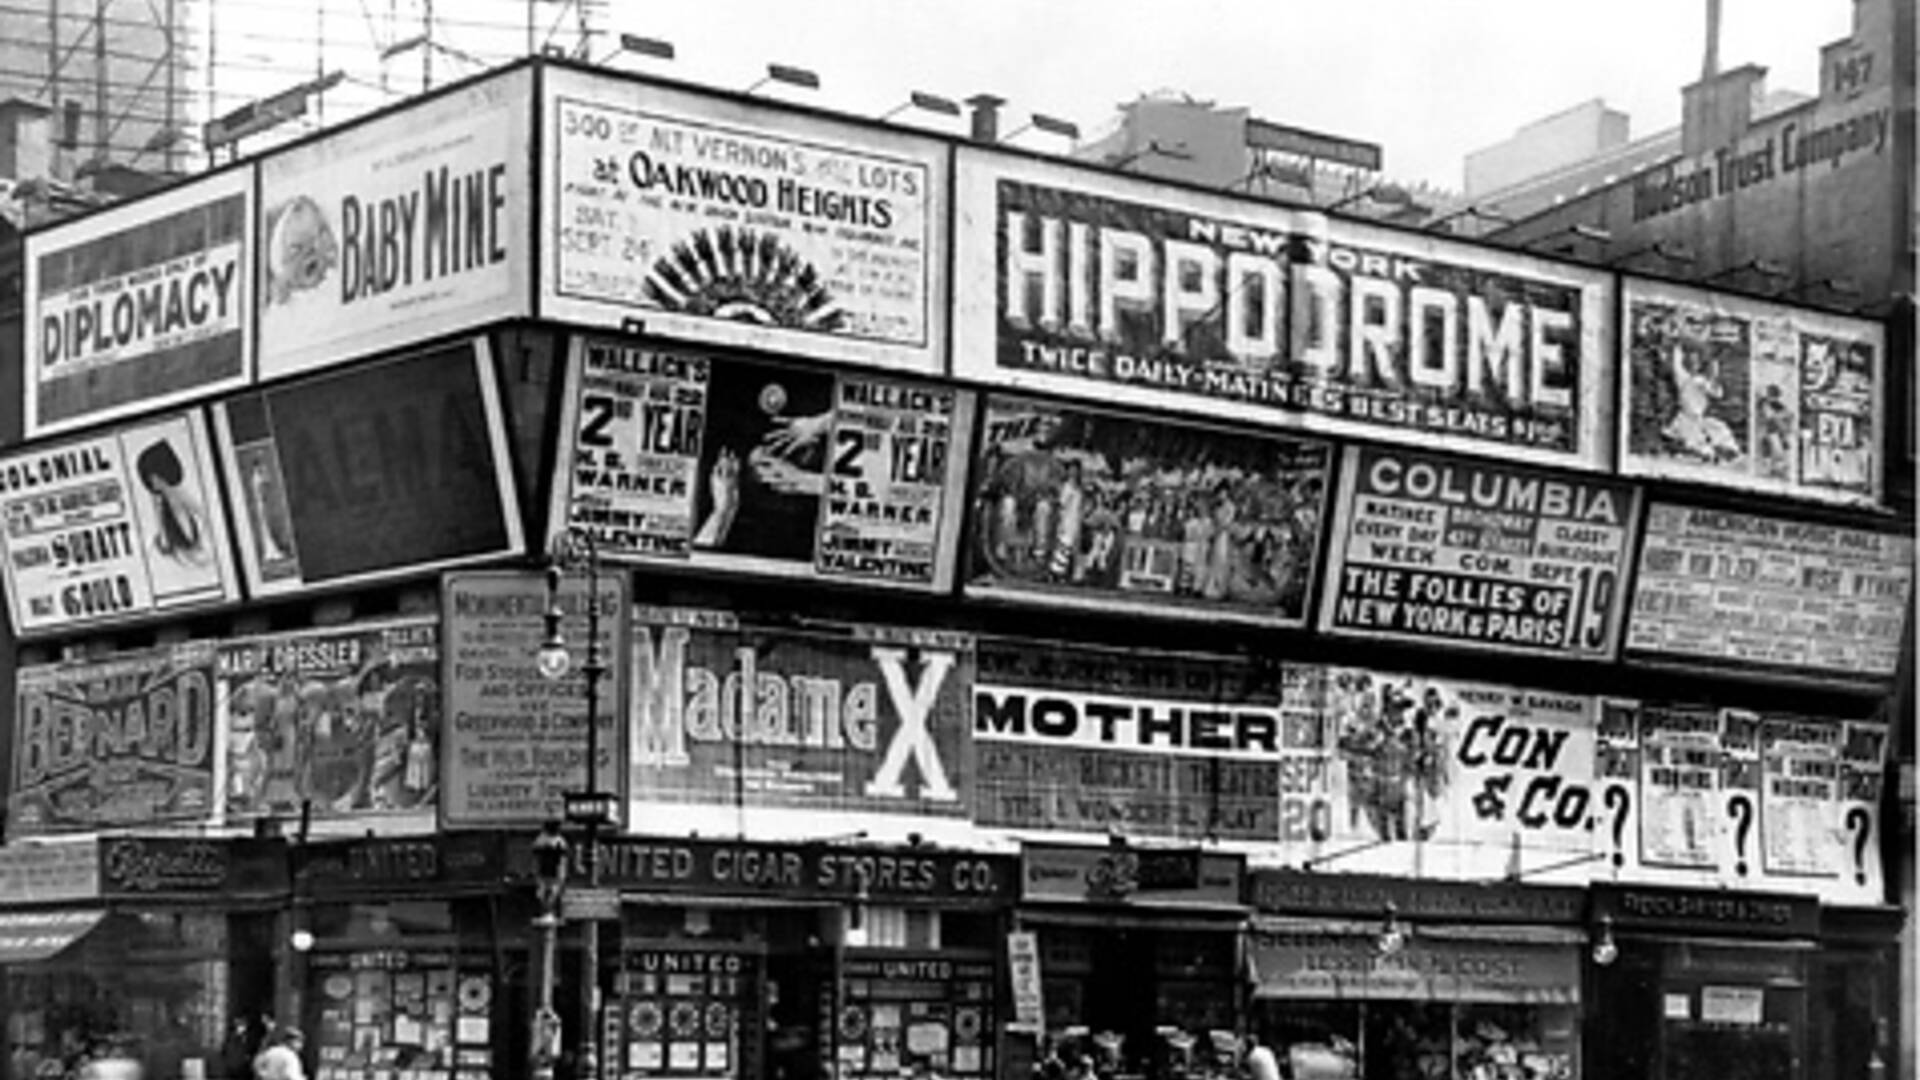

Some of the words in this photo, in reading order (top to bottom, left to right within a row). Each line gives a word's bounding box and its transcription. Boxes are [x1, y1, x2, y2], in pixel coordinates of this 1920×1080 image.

[565, 111, 610, 139] 300
[858, 164, 917, 196] LOTS
[1715, 138, 1774, 196] Trust
[1782, 107, 1889, 173] Company
[629, 151, 767, 209] OAKWOOD
[778, 178, 892, 229] HEIGHTS
[342, 191, 419, 305] BABY
[425, 164, 505, 281] MINE
[1189, 219, 1288, 259] NEW
[1307, 243, 1421, 281] YORK
[43, 261, 235, 366] DIPLOMACY
[1004, 210, 1572, 405] HIPPODROME
[1020, 341, 1103, 374] TWICE
[1351, 397, 1419, 425] BEST
[1427, 404, 1504, 434] SEATS
[641, 406, 699, 455] YEAR
[577, 470, 686, 497] WARNER
[890, 437, 945, 485] YEAR
[1370, 458, 1617, 522] COLUMBIA
[830, 502, 932, 524] WARNER
[1370, 543, 1433, 564] WEEK
[1339, 599, 1398, 624] NEW
[1348, 567, 1400, 596] THE
[1410, 574, 1525, 612] FOLLIES
[1533, 590, 1567, 616] OF
[275, 639, 360, 671] DRESSLER
[21, 670, 210, 787] BERNARD
[632, 626, 877, 769] Madame
[864, 647, 956, 800] X
[975, 692, 1279, 751] MOTHER
[1460, 715, 1569, 770] CON
[1284, 798, 1331, 841] 20
[1473, 774, 1513, 820] &
[1604, 784, 1629, 867] ?
[1728, 795, 1752, 876] ?
[1846, 808, 1869, 886] ?
[713, 850, 799, 883] CIGAR
[817, 856, 935, 891] STORES
[952, 862, 998, 892] CO.
[643, 951, 742, 972] UNITED
